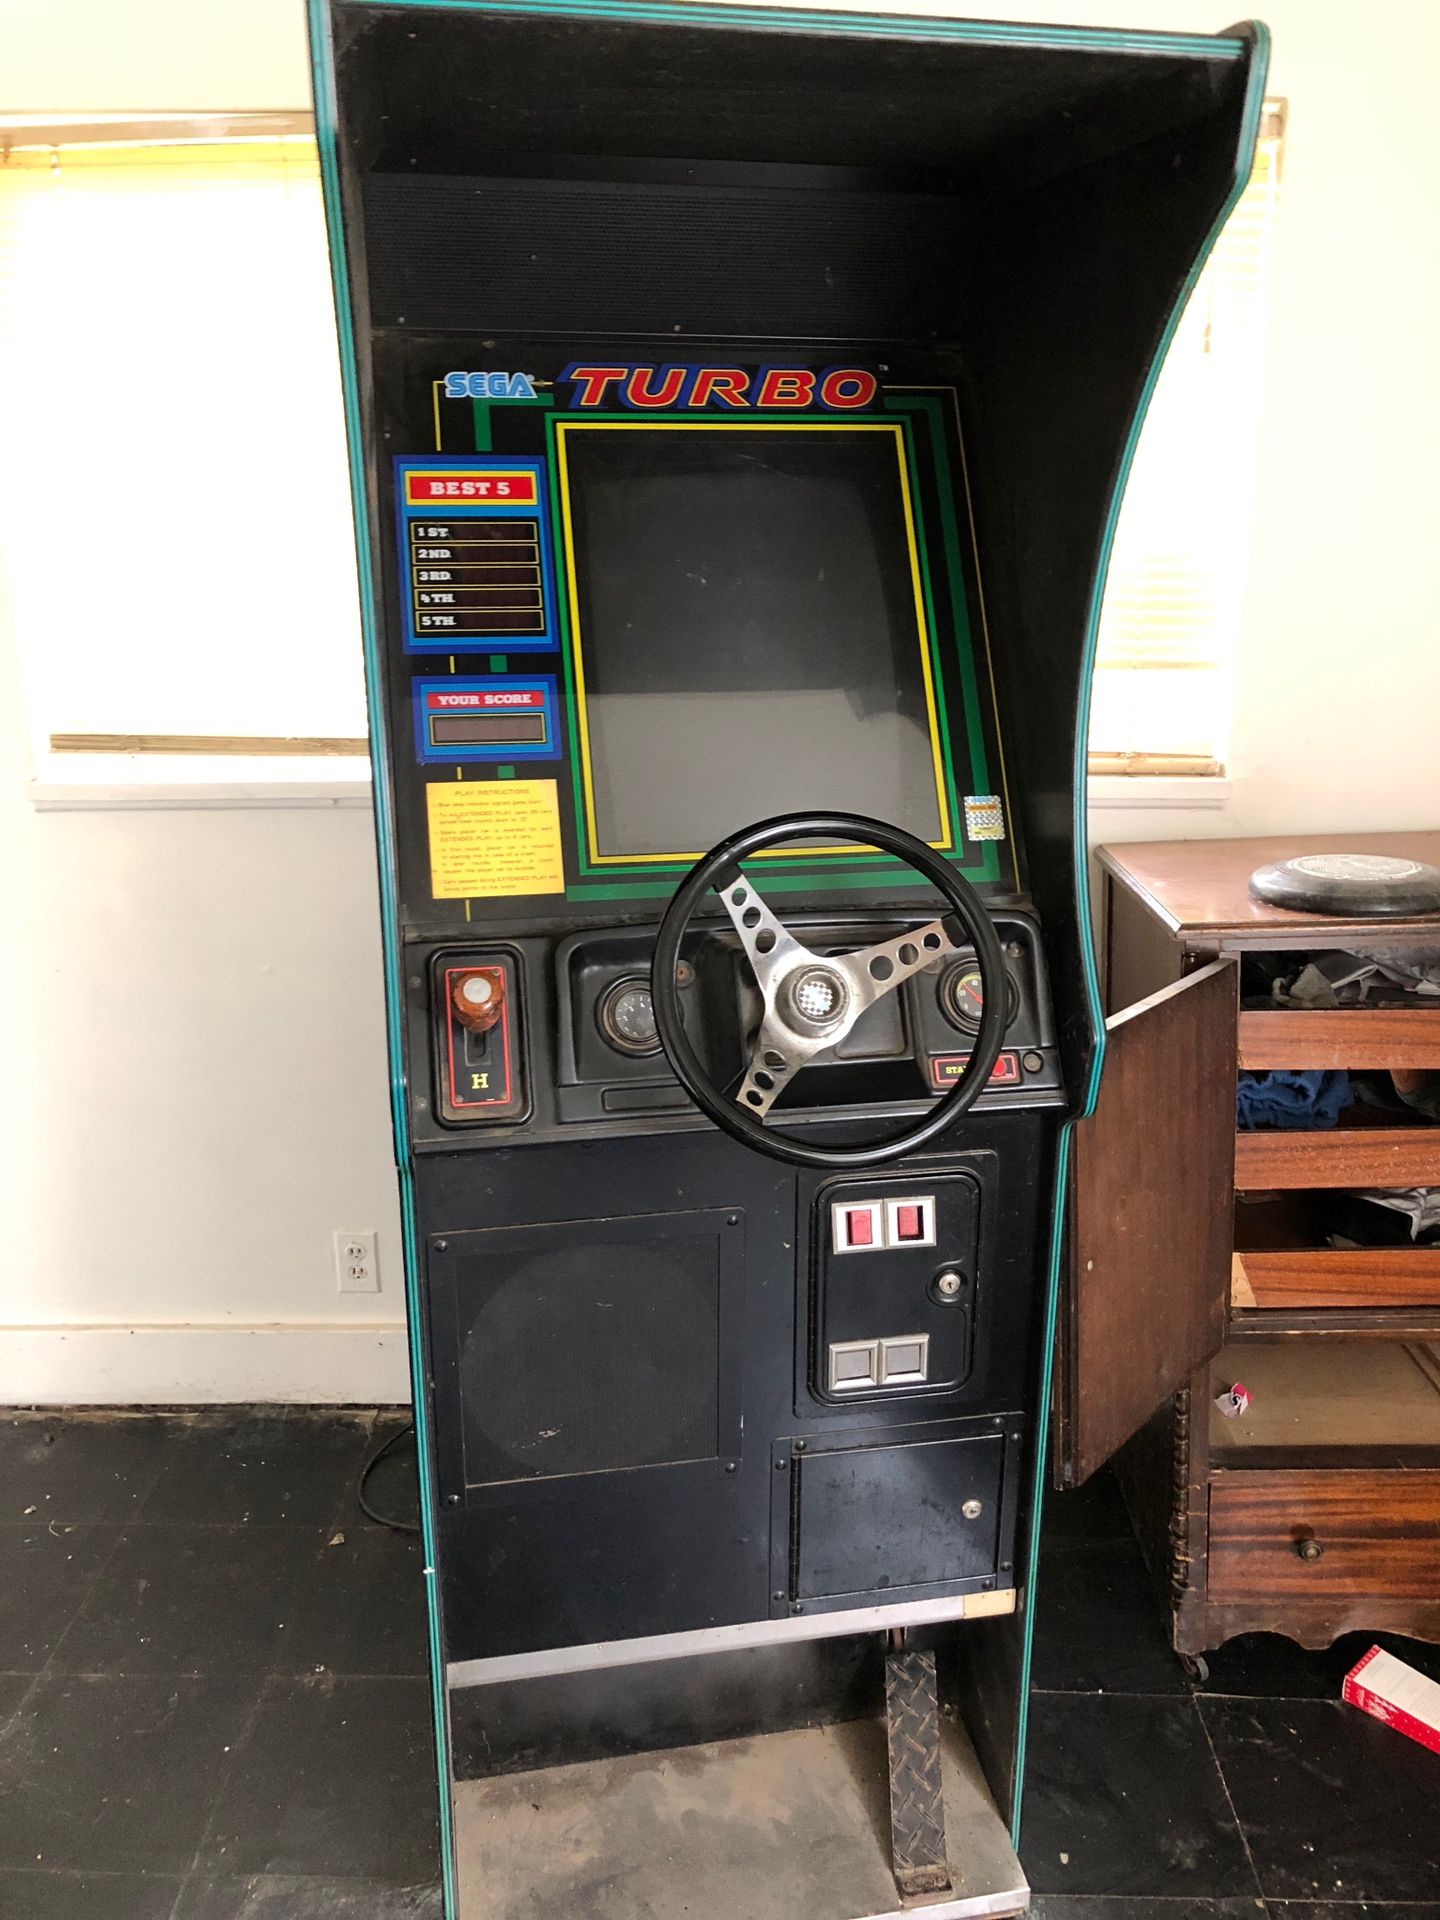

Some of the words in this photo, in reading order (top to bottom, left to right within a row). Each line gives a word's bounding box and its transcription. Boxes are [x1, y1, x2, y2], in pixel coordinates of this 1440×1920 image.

[444, 371, 537, 399] SEGA
[563, 364, 878, 410] TURBO
[430, 481, 491, 495] BEST
[496, 481, 511, 495] 5
[437, 695, 481, 706] YOUR
[484, 693, 532, 705] SCORE
[945, 1065, 967, 1074] STA
[471, 1073, 489, 1089] H
